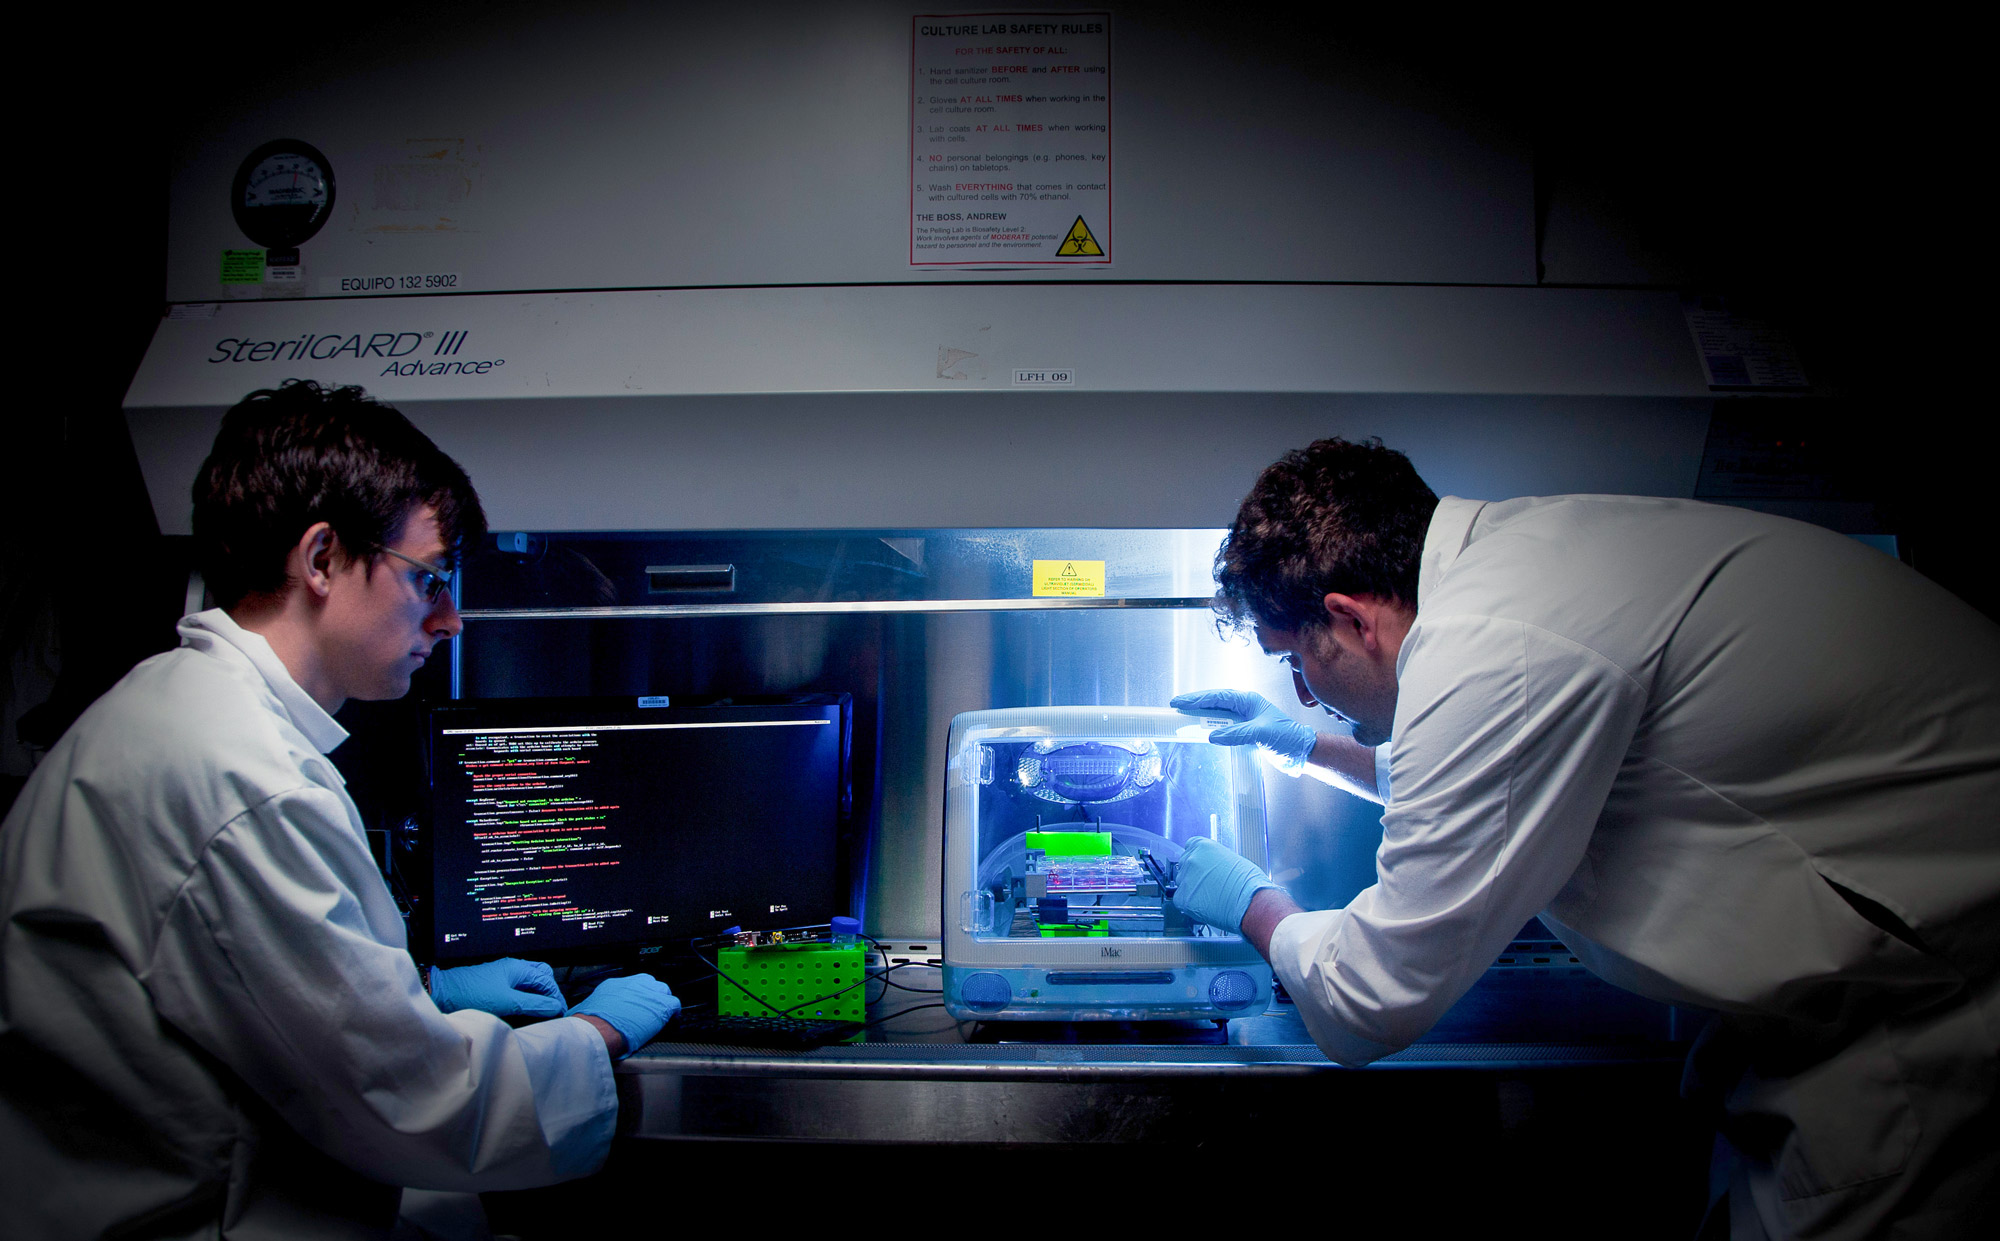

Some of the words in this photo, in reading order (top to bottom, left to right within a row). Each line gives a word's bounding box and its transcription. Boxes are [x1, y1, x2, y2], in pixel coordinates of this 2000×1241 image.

[920, 25, 979, 36] CULTURE
[982, 24, 1006, 34] LAB
[1010, 24, 1058, 34] SAFETY
[1062, 23, 1103, 34] RULES
[1084, 66, 1106, 74] using
[1049, 95, 1081, 103] working
[930, 106, 943, 114] cell
[930, 125, 944, 133] Lab
[1075, 124, 1106, 133] working
[947, 155, 981, 163] personal
[985, 154, 1029, 163] belongings
[1033, 154, 1050, 162] (e.g.
[1055, 154, 1087, 162] phones,
[1091, 154, 1106, 162] key
[972, 164, 1010, 172] tabletops.
[937, 214, 964, 222] BOSS,
[946, 242, 977, 250] personnel
[342, 277, 394, 290] EQUIPO
[400, 276, 421, 288] 132
[426, 275, 457, 287] 5902
[1020, 373, 1044, 381] LFH
[1052, 373, 1067, 381] 09
[640, 946, 663, 954] acer
[1101, 947, 1122, 957] iMac
